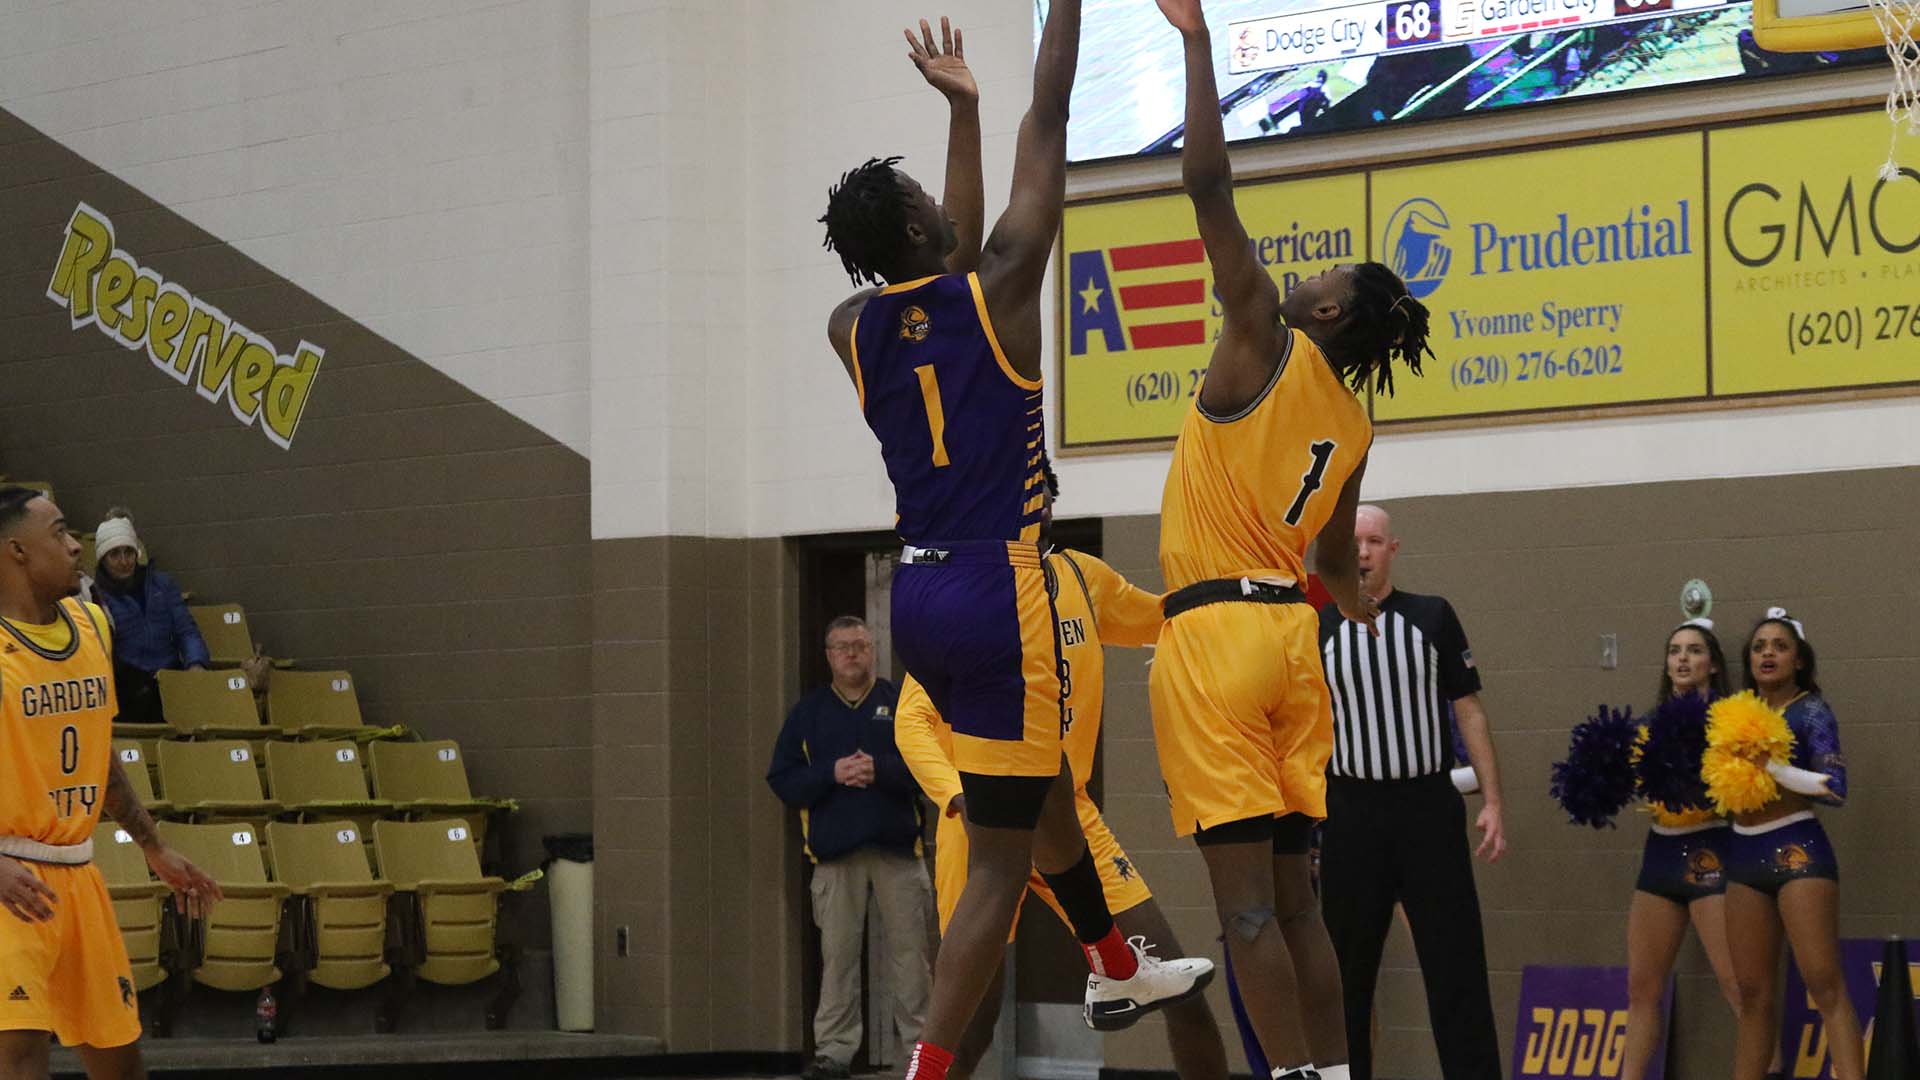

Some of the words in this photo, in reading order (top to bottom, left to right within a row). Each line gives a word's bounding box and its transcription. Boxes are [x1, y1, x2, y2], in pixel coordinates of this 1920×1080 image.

[1266, 24, 1325, 54] Dodge
[1331, 18, 1366, 47] City
[1395, 2, 1431, 41] 68
[1248, 221, 1353, 266] erican
[1469, 200, 1692, 276] Prudential
[1735, 270, 1847, 292] ARCHITECTS
[1880, 263, 1920, 281] PLA
[48, 203, 324, 448] Reserved
[1449, 311, 1533, 339] Yvonne
[1541, 301, 1623, 338] Sperry
[1788, 307, 1862, 354] (620)
[1126, 371, 1180, 408] (620)
[1188, 368, 1208, 397] 2
[1451, 356, 1508, 390] (620)
[1516, 345, 1623, 381] 276-6202
[913, 363, 951, 468] 1
[1283, 438, 1336, 527] 1
[22, 676, 108, 717] GARDEN
[60, 726, 79, 775] 0
[48, 785, 98, 818] ITY
